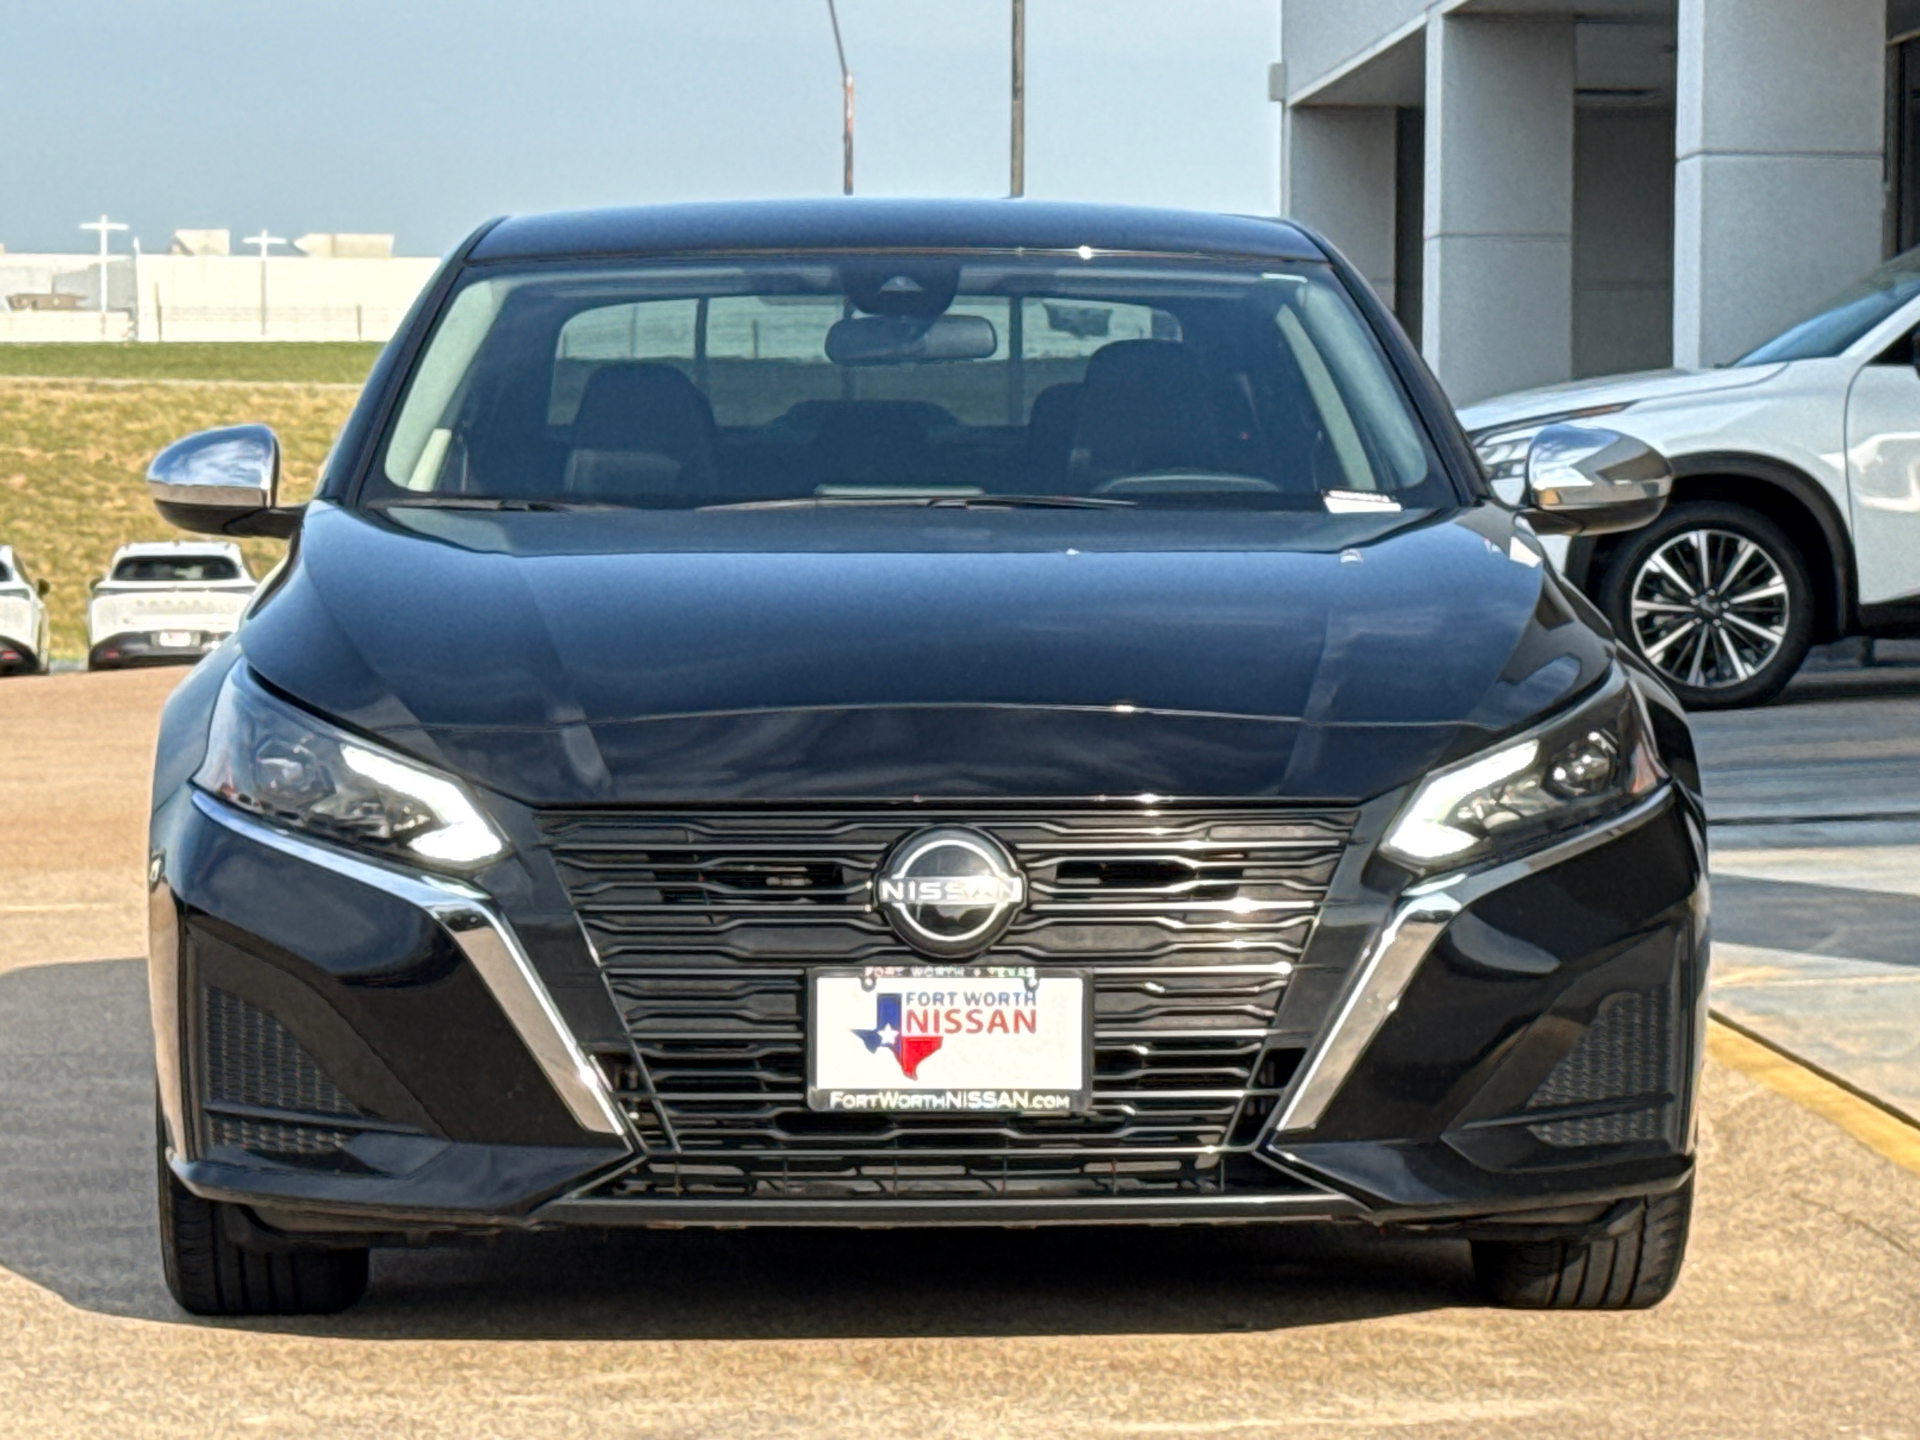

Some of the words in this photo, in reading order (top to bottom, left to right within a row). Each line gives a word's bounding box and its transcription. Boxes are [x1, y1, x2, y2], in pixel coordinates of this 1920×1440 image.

[881, 881, 1018, 900] NISSAN
[906, 992, 958, 1006] FORT
[963, 992, 1037, 1006] WORTH
[906, 1009, 1037, 1034] NISSAN
